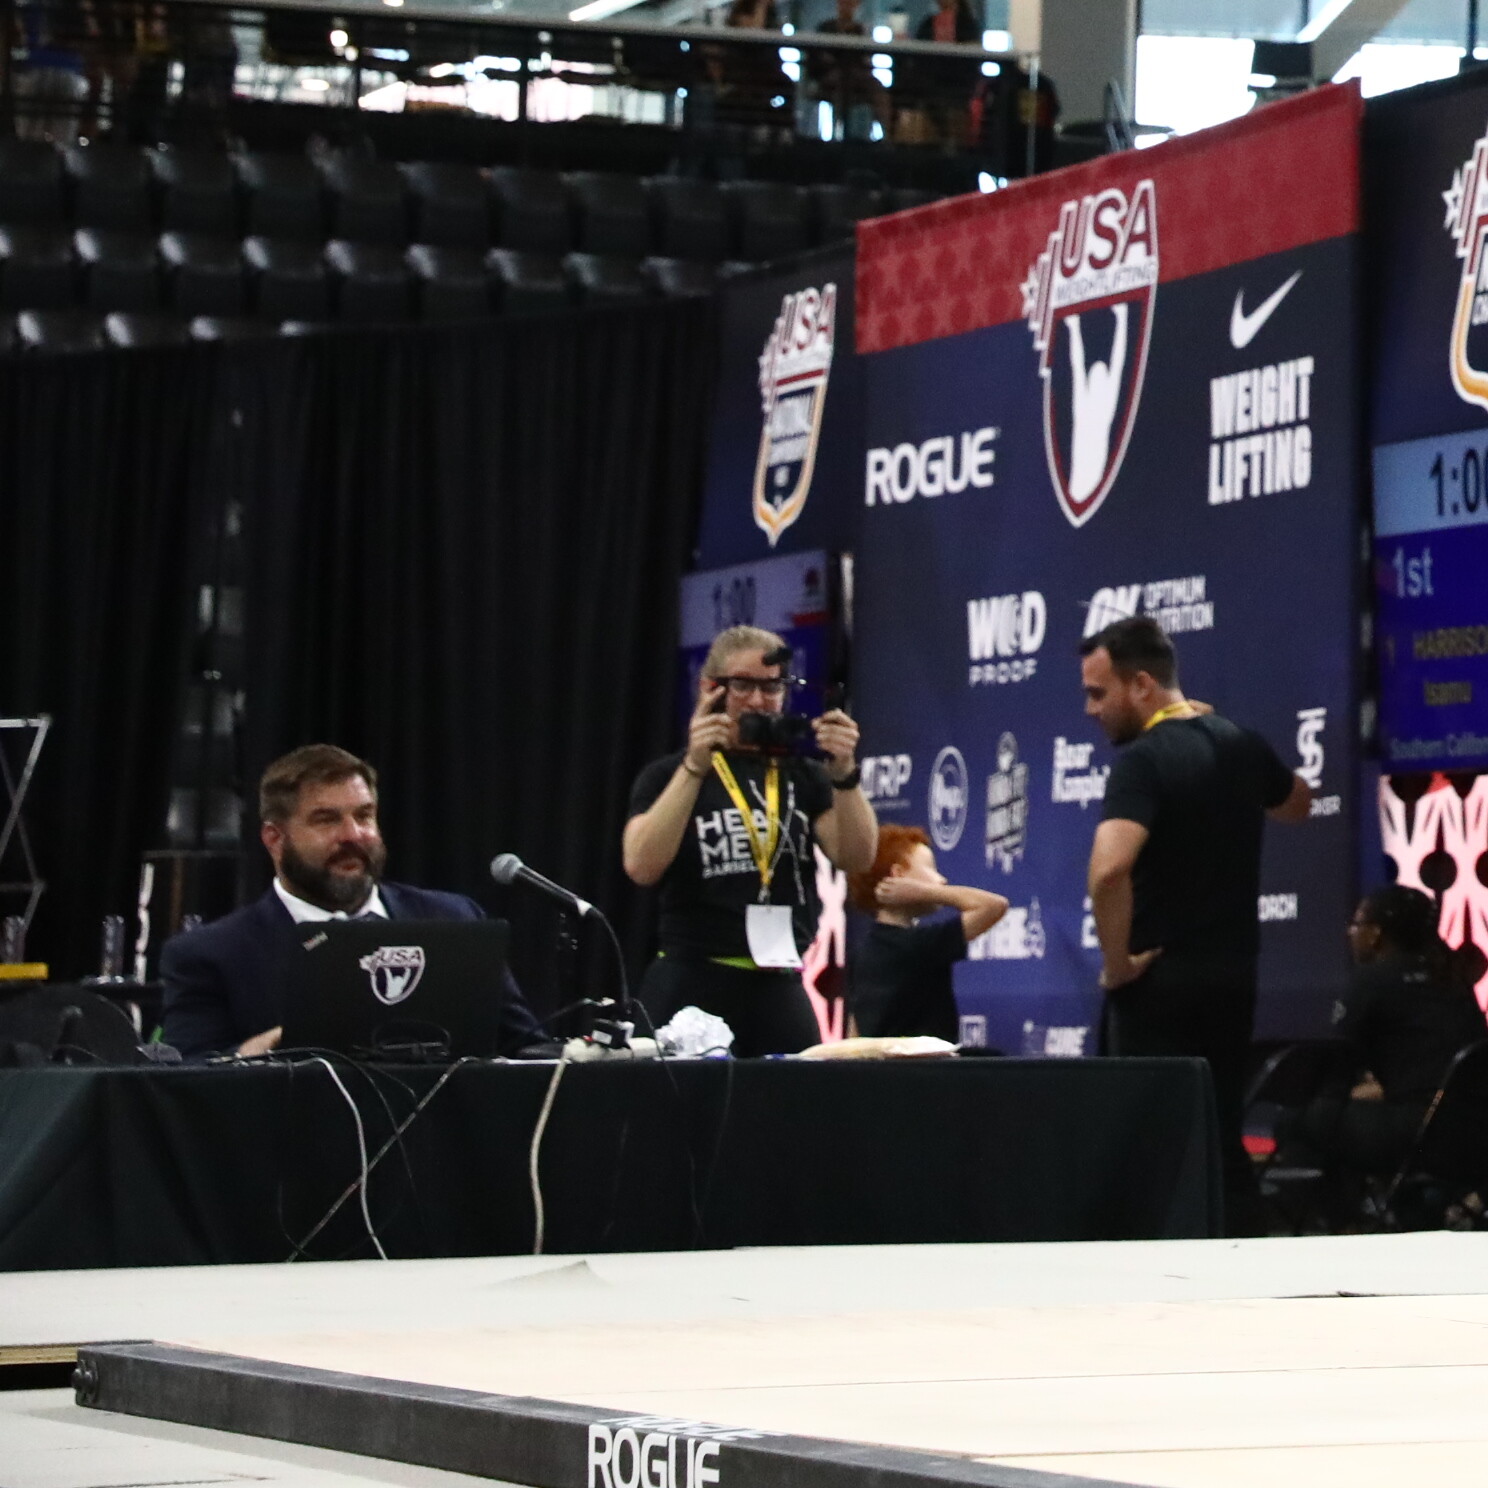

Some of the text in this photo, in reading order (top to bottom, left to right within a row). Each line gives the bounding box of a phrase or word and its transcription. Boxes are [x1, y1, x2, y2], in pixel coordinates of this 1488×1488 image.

[1060, 184, 1155, 280] USA
[1209, 356, 1315, 439] WEIGHT
[865, 428, 996, 507] ROGUE
[1207, 425, 1313, 506] LIFTING
[1392, 546, 1434, 599] 1st
[969, 658, 1037, 687] PROOF
